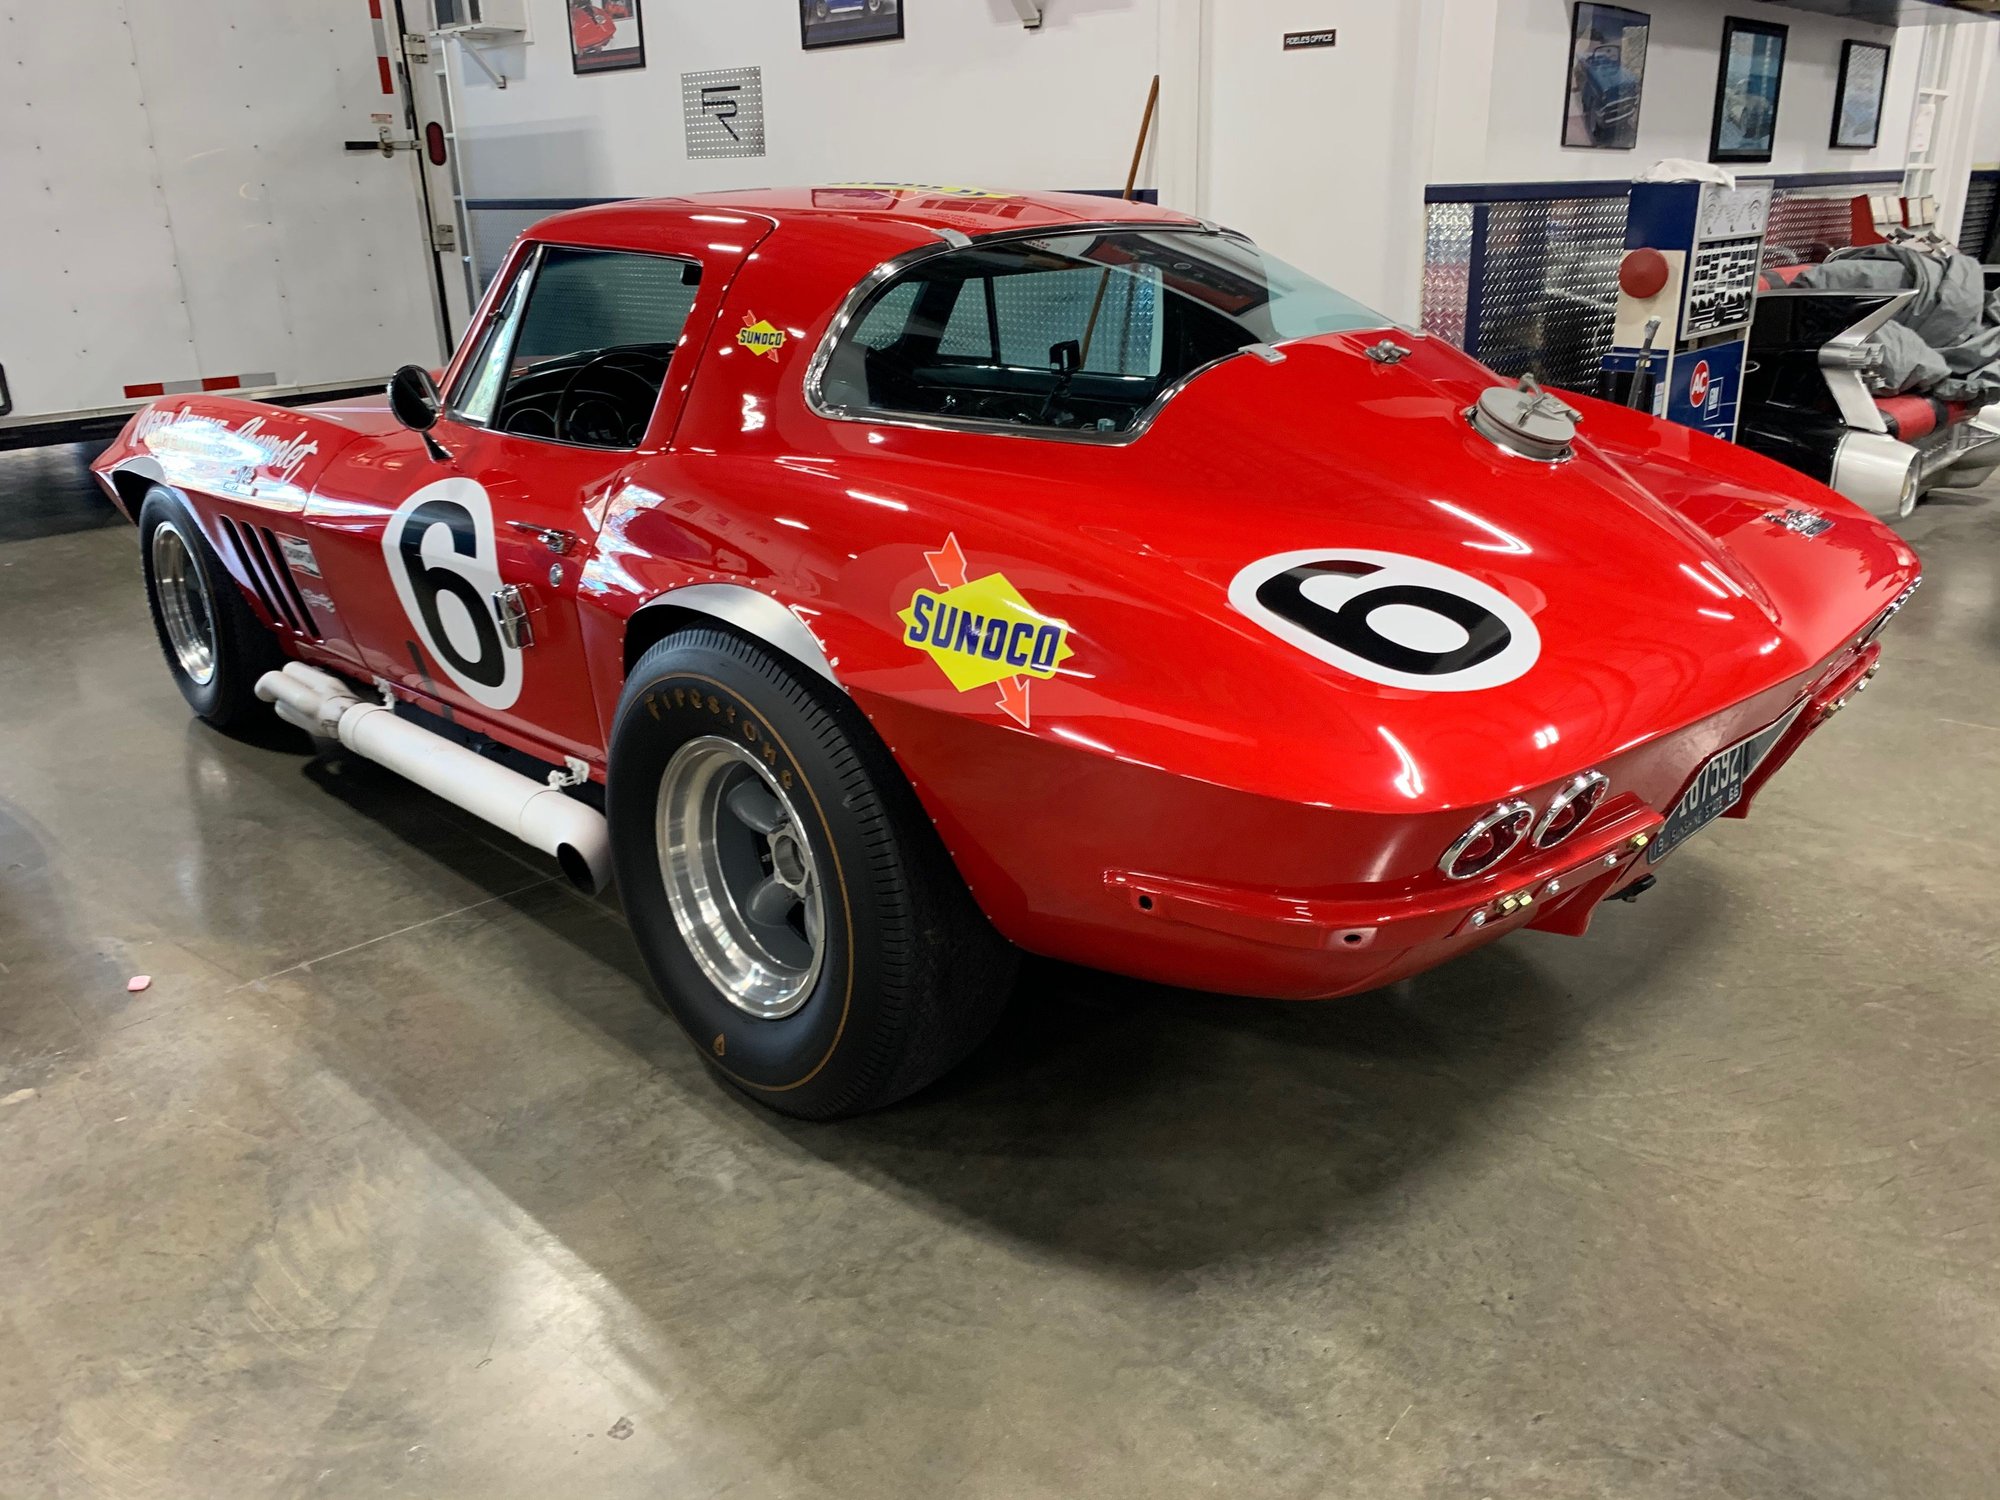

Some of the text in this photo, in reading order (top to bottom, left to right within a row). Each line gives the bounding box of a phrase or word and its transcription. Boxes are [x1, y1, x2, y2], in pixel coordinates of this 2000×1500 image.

[1311, 33, 1333, 43] OFFICE
[740, 329, 783, 346] SUNOCO
[1691, 371, 1707, 395] AC
[399, 500, 505, 688] 6
[1256, 559, 1512, 676] 6
[909, 594, 1061, 673] SUNOCO
